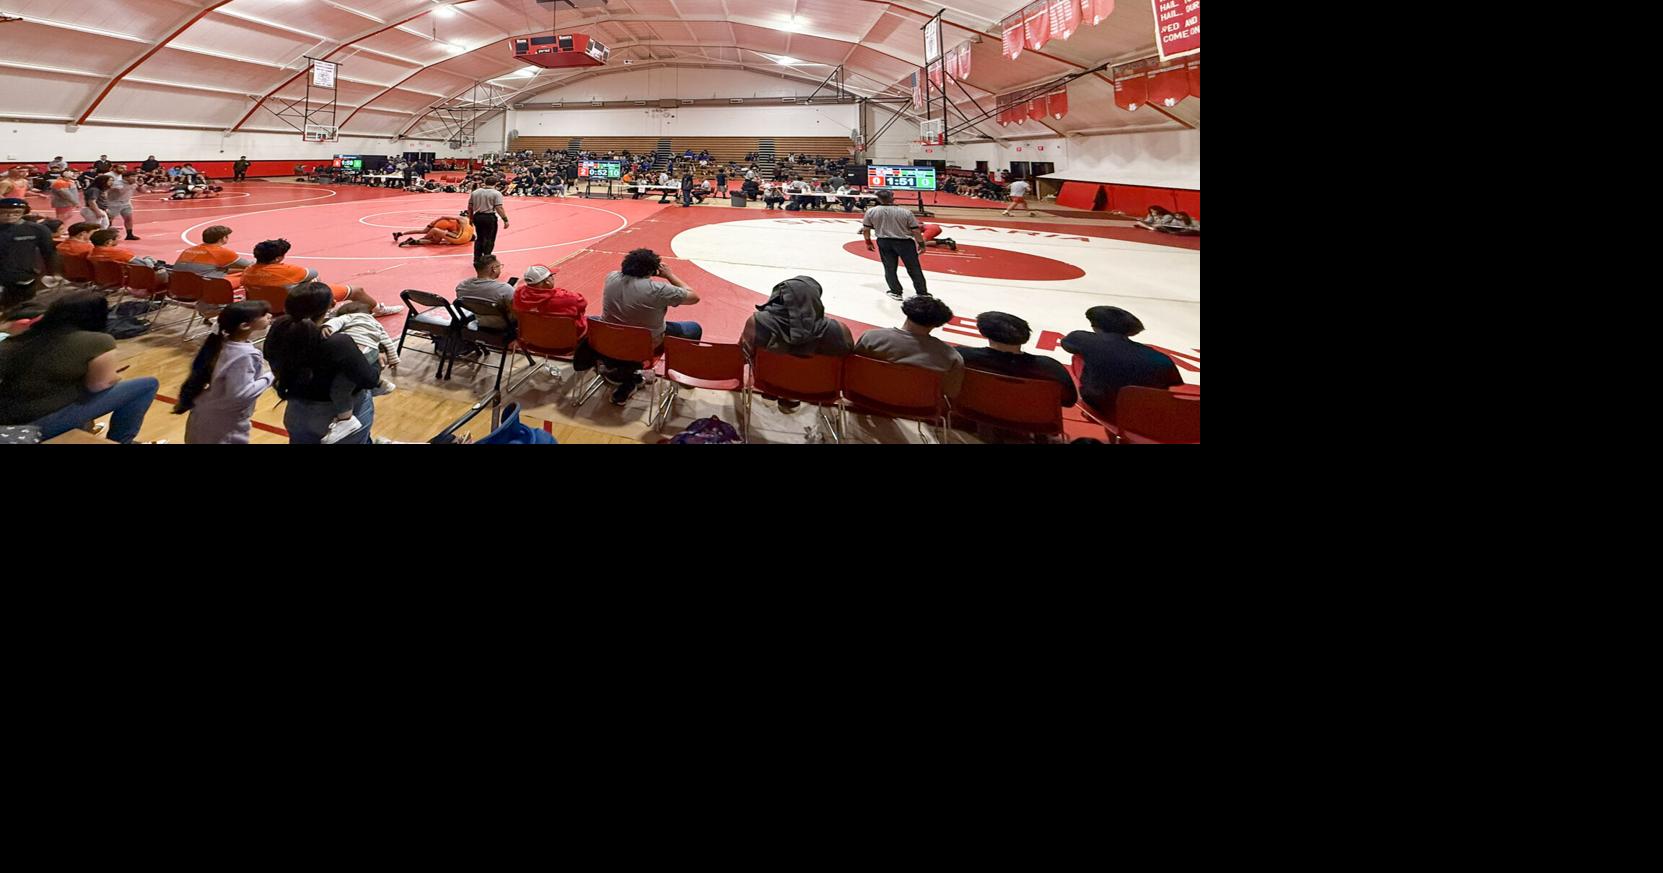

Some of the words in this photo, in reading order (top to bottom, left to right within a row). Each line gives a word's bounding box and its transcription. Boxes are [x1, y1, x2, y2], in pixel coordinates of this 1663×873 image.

[1185, 16, 1198, 28] AND
[1163, 29, 1190, 43] COME
[886, 177, 914, 186] 1:51
